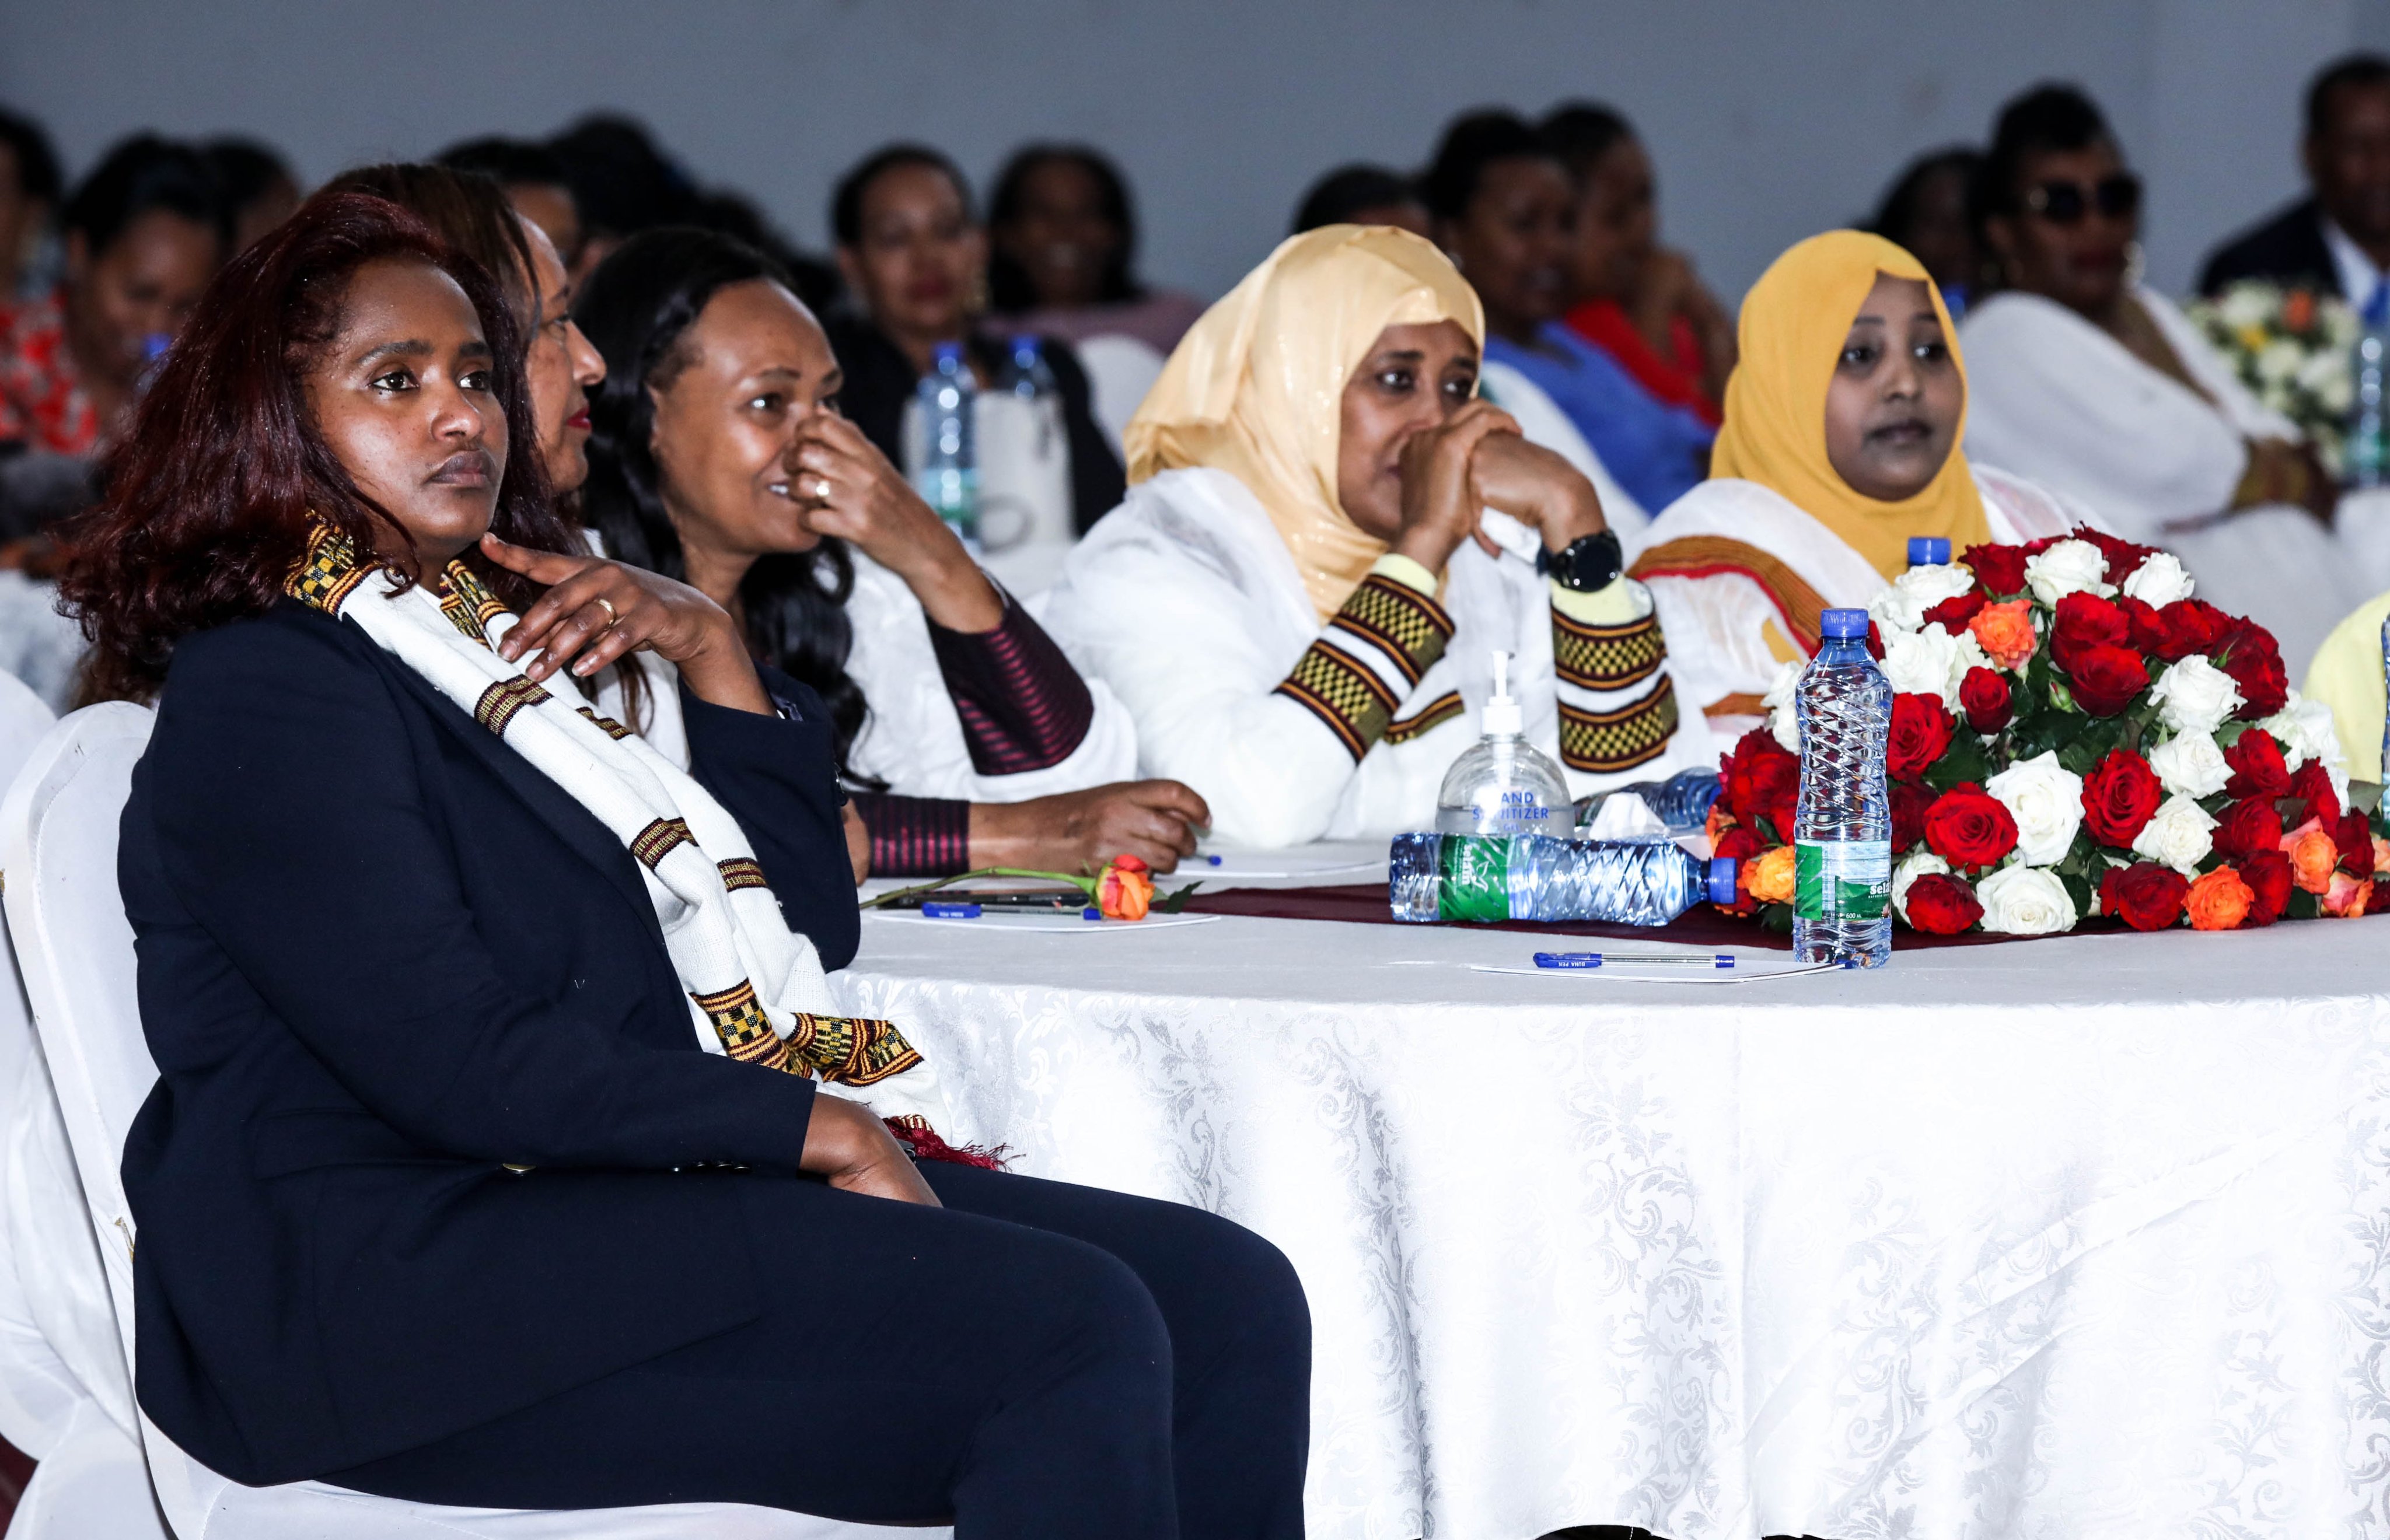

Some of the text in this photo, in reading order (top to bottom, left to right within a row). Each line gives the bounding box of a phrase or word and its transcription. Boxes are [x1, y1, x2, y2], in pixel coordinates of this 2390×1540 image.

[1501, 792, 1534, 804] AND
[1473, 807, 1549, 820] SNITIZER
[1462, 844, 1475, 885] selam
